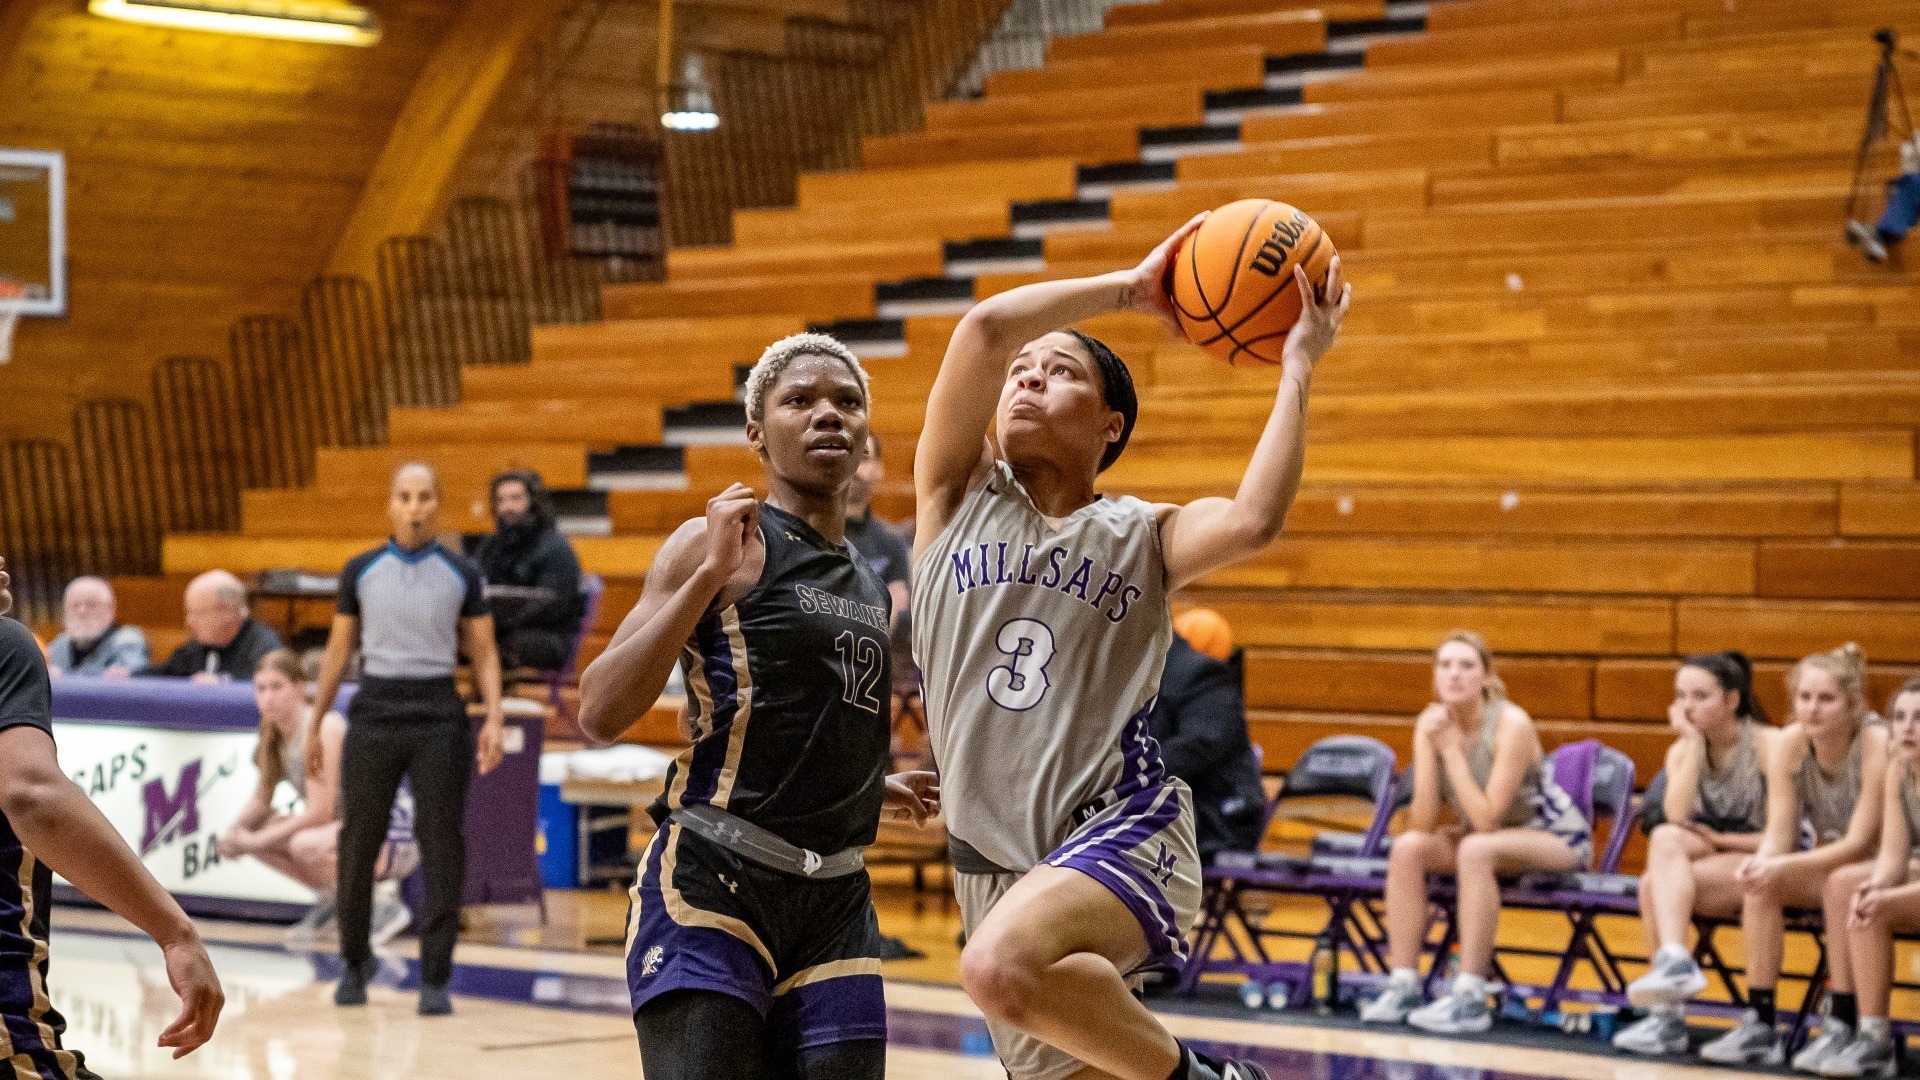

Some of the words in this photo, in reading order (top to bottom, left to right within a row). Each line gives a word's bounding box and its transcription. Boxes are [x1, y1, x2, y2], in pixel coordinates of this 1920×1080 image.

[1249, 211, 1308, 276] Wilso
[795, 584, 889, 632] SEWANE
[952, 542, 1142, 623] MILLSAPS
[835, 630, 883, 714] 12
[986, 617, 1057, 712] 3
[138, 756, 203, 858] M
[1082, 805, 1097, 820] M
[182, 832, 221, 880] BA
[1149, 840, 1178, 888] M
